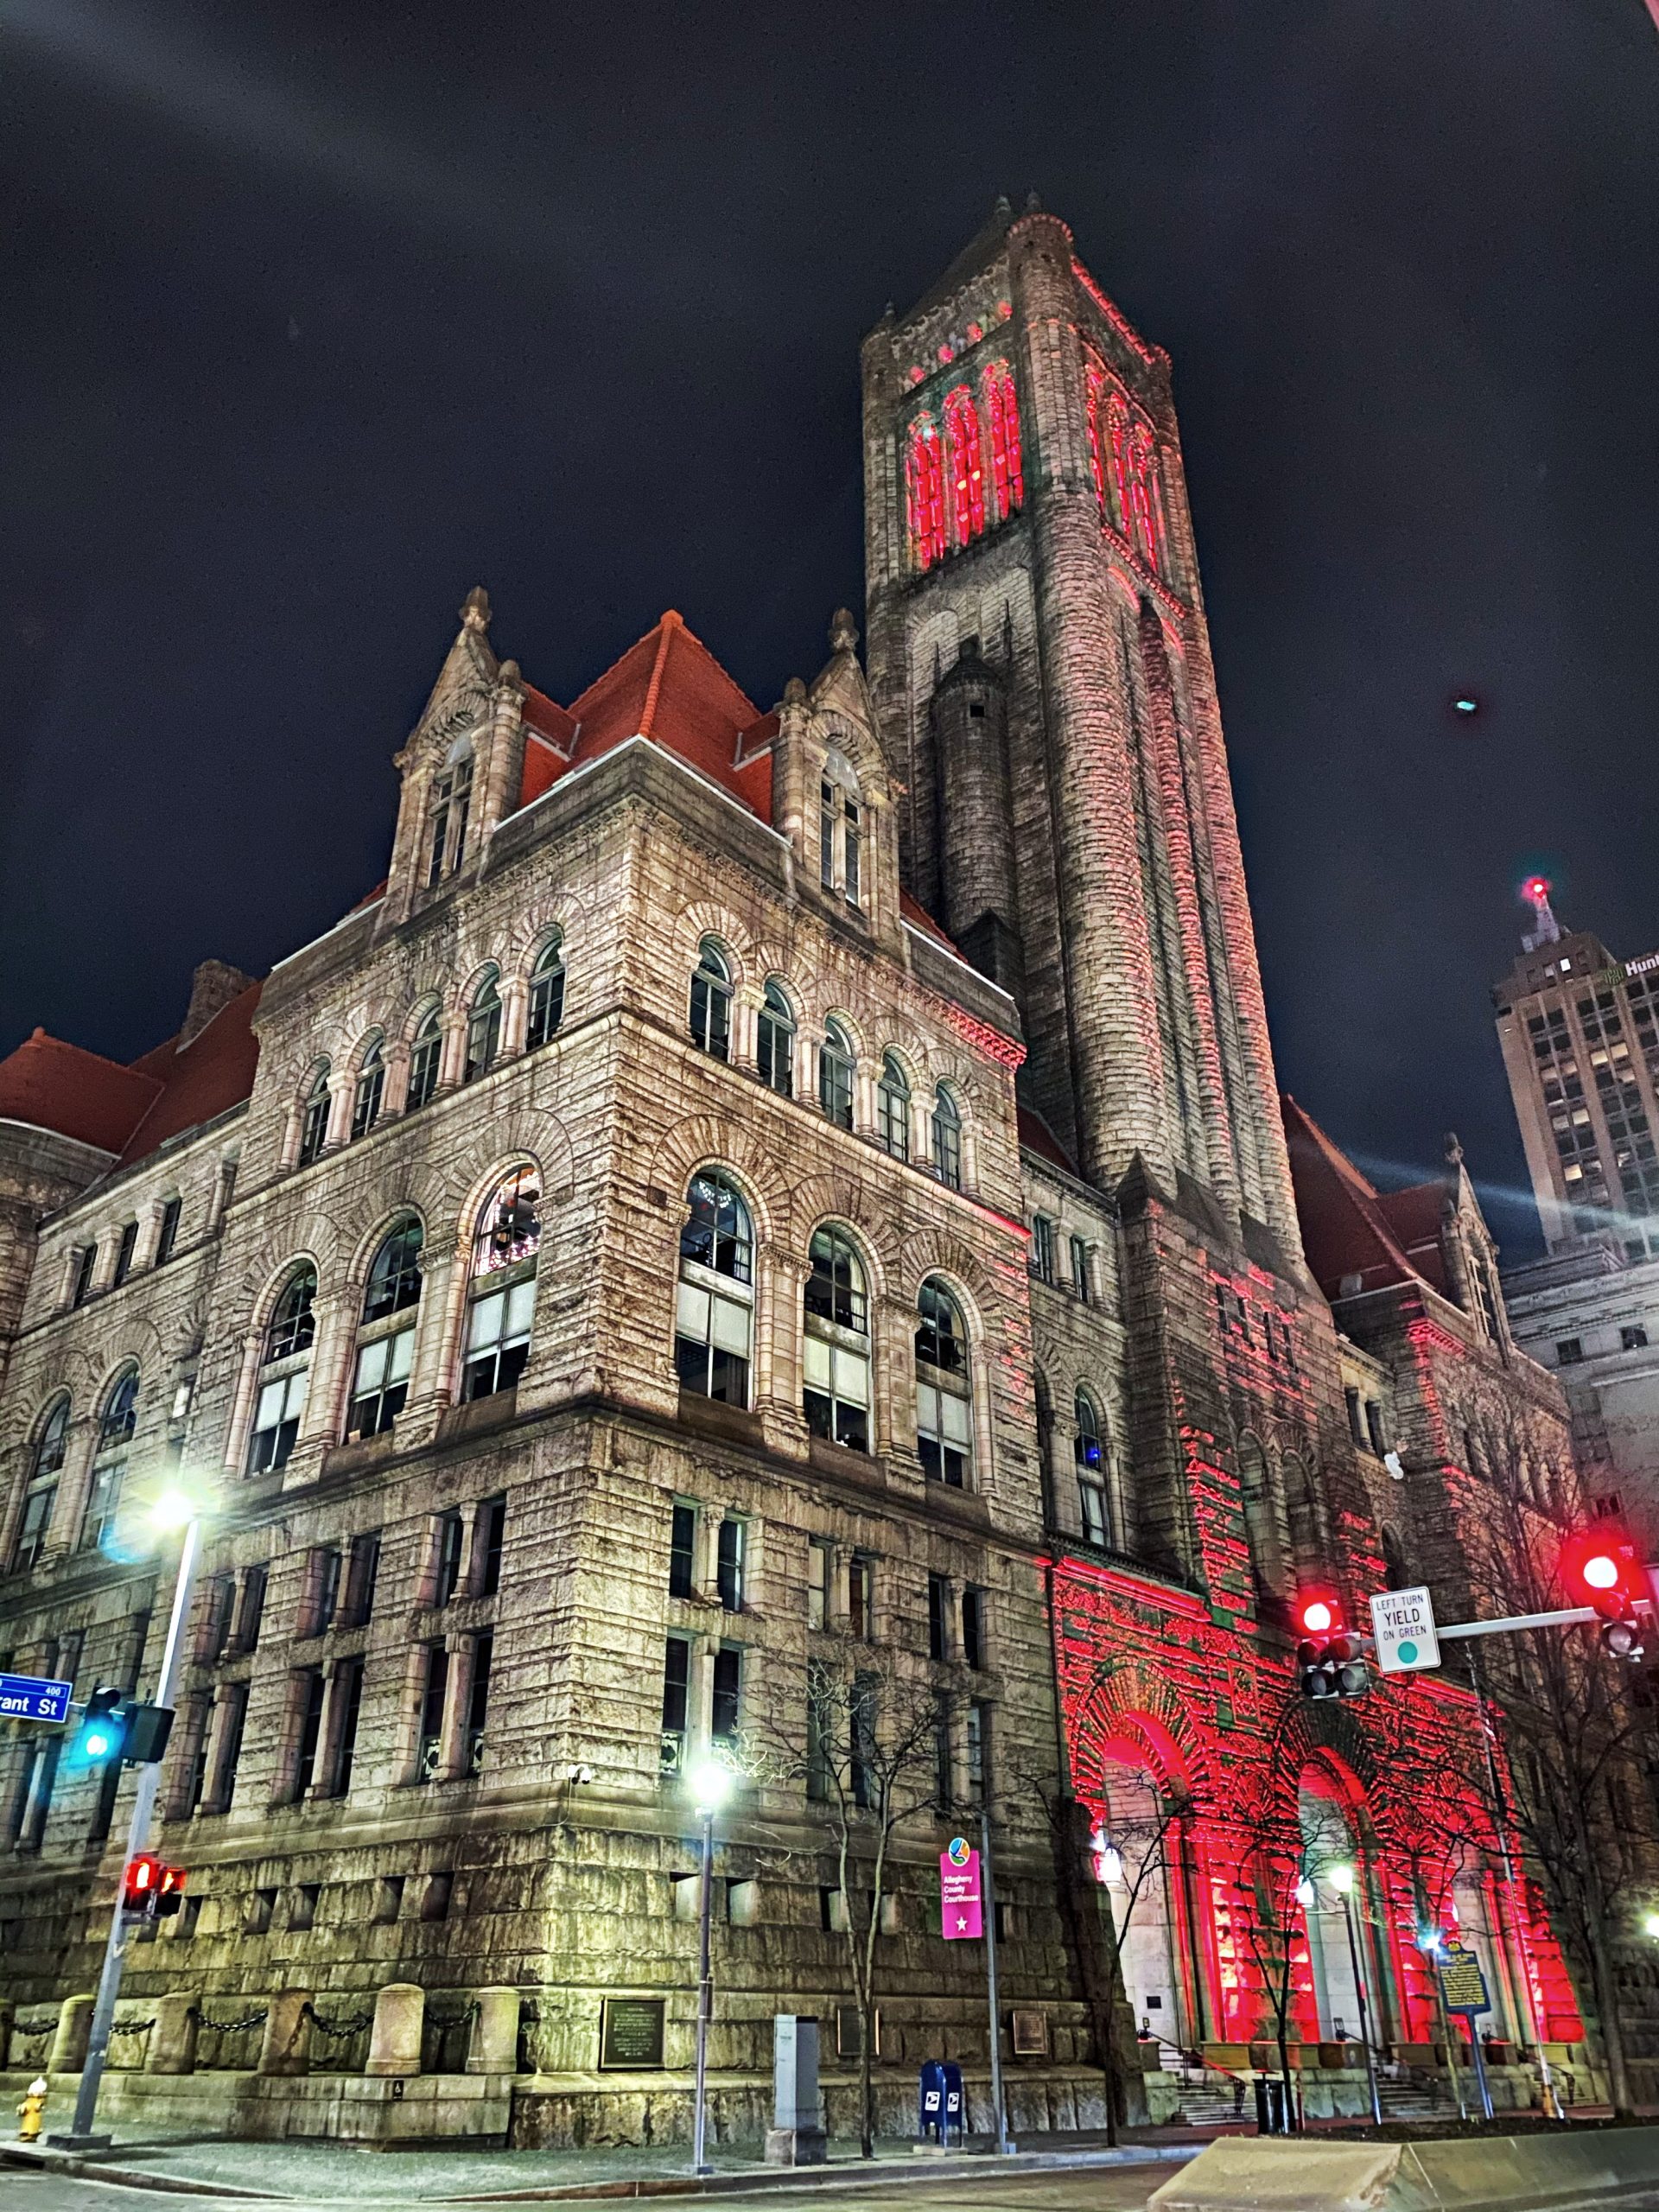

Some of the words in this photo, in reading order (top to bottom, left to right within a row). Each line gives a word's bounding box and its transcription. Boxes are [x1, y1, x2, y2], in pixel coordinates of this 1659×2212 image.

[1376, 1598, 1396, 1611] LEFT
[1402, 1594, 1424, 1607] TURN
[1384, 1608, 1421, 1626] YIELD
[1382, 1630, 1395, 1641] ON
[1399, 1624, 1427, 1638] GREEN
[45, 1687, 61, 1696] 400
[0, 1696, 29, 1712] ant
[37, 1698, 58, 1716] St
[944, 1875, 973, 1885] Allegheny
[944, 1885, 965, 1894] County
